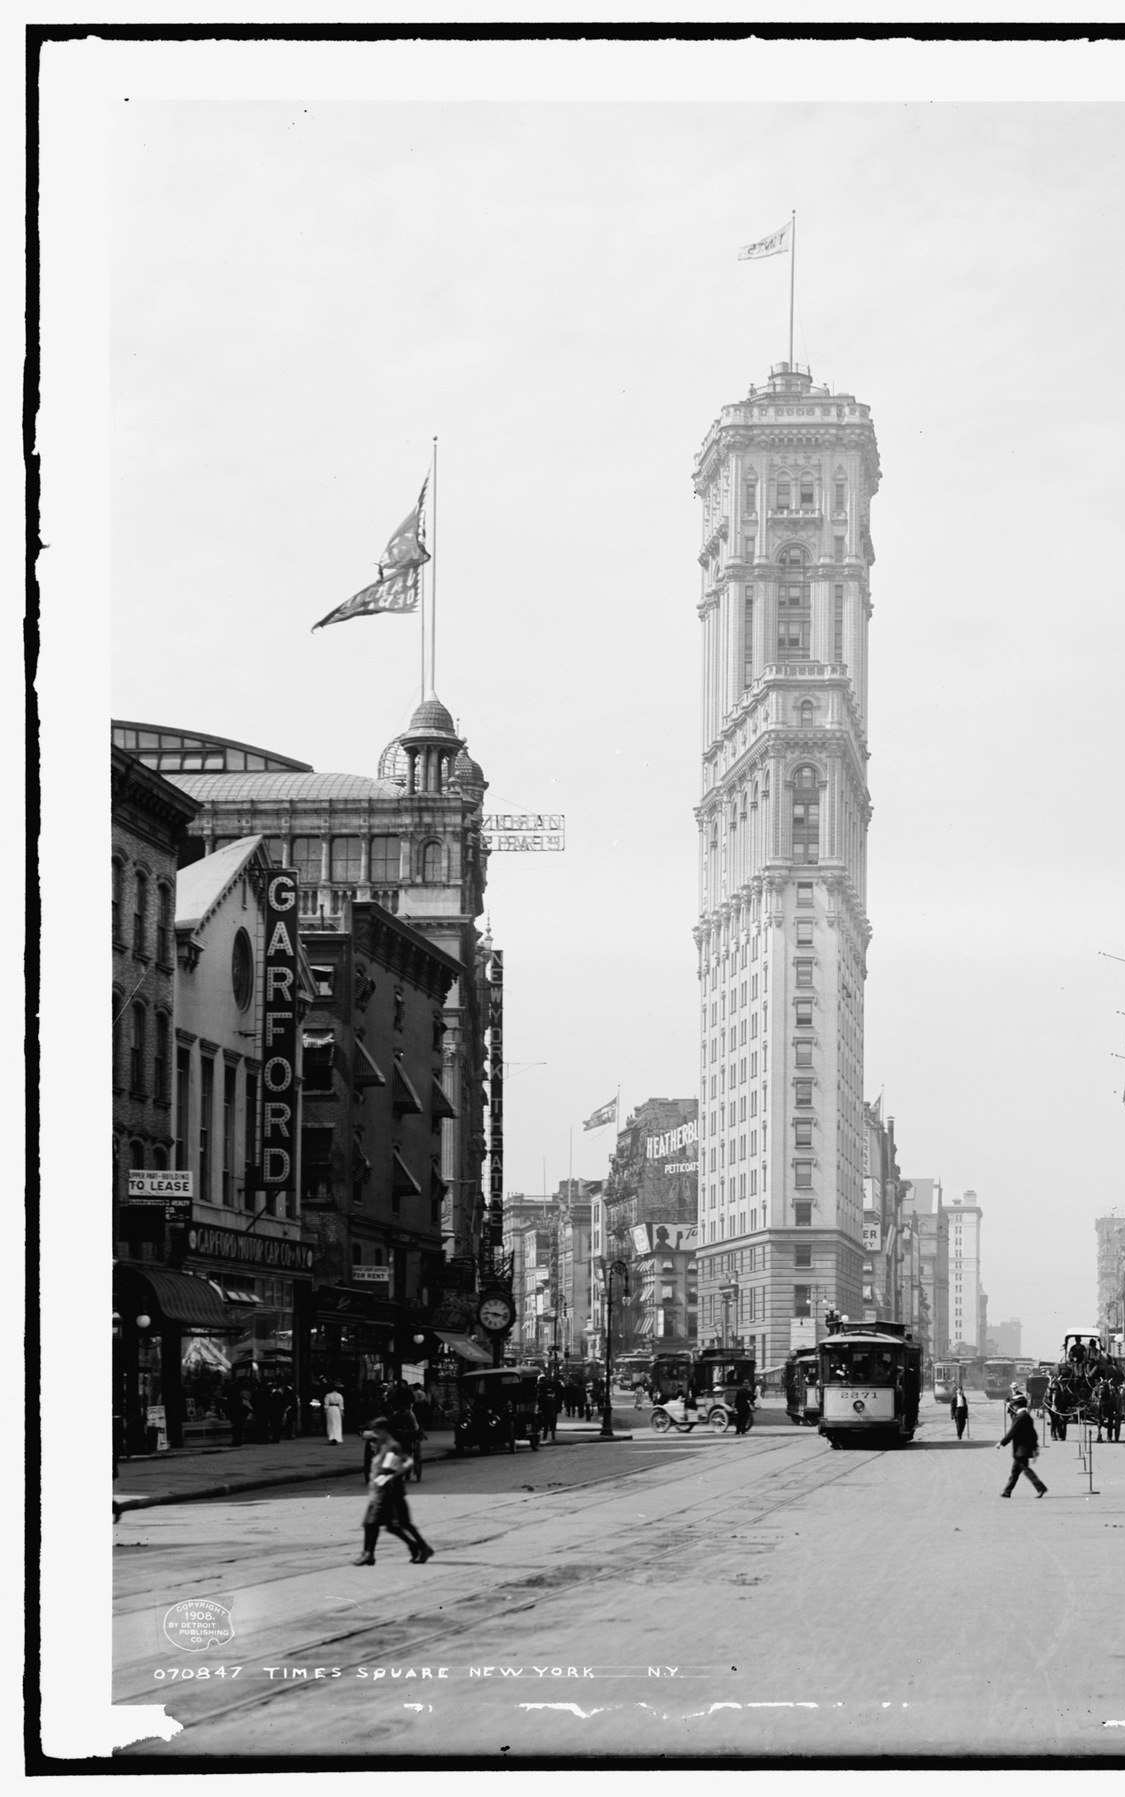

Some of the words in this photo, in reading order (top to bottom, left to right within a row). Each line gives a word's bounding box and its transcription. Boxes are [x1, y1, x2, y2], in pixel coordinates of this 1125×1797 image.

[490, 951, 502, 1002] NEW
[263, 875, 296, 1184] GARFORD
[490, 1007, 502, 1080] YORK
[129, 1180, 145, 1190] TO
[150, 1181, 190, 1191] LEASE
[490, 1097, 502, 1228] THEATRE
[237, 1235, 264, 1262] MOTOR
[264, 1240, 280, 1265] CAR
